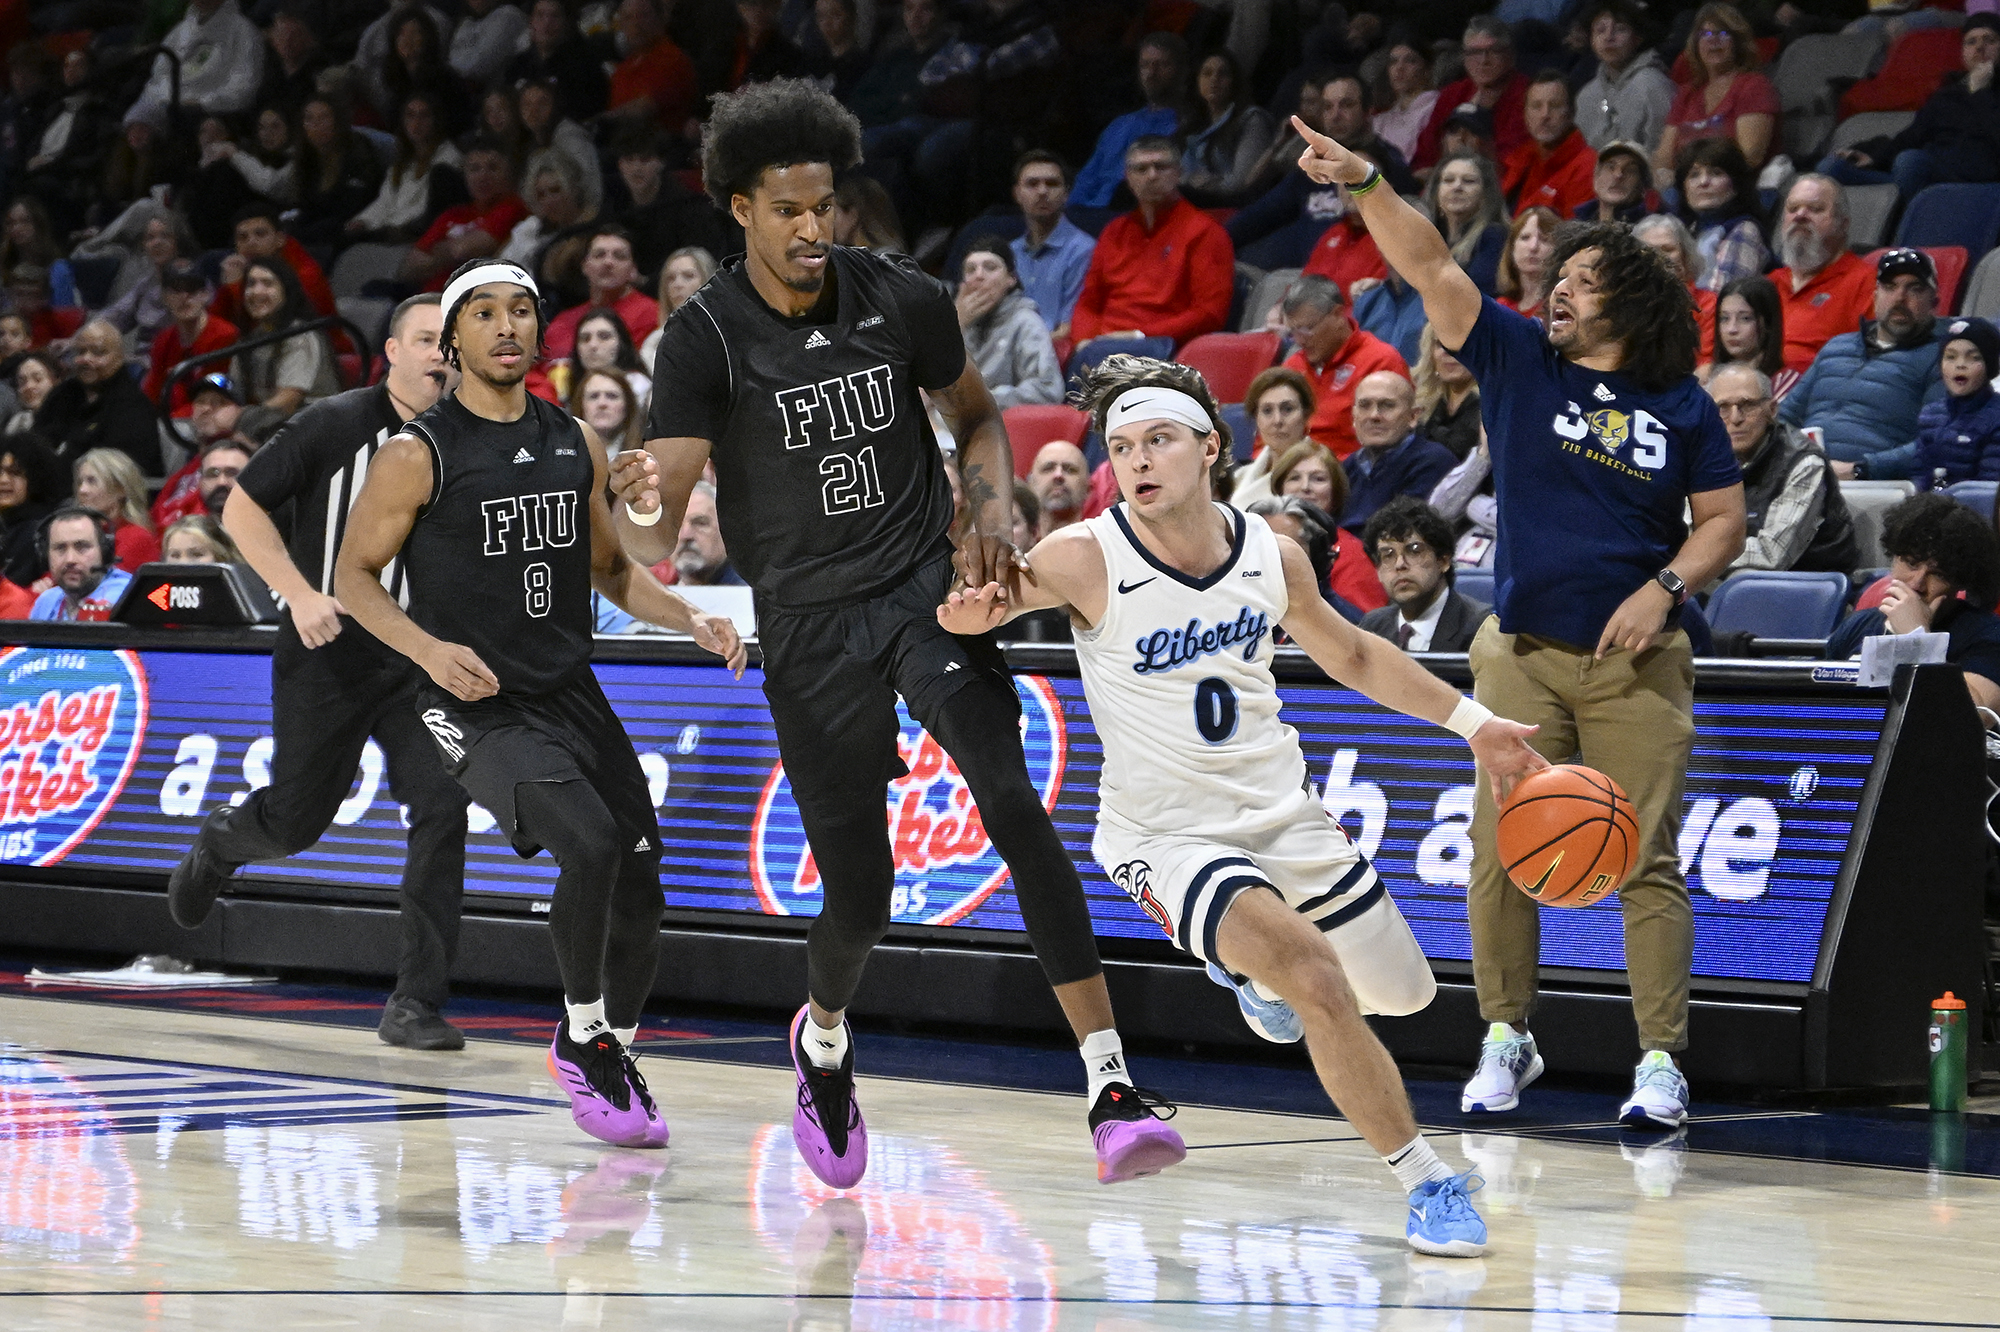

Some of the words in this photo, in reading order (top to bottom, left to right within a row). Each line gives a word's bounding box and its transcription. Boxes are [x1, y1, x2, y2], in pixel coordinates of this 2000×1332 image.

[775, 364, 895, 449] FIU
[819, 446, 885, 516] 21
[1562, 441, 1581, 454] FIU
[481, 490, 577, 556] FIU
[170, 586, 200, 608] POSS
[524, 562, 551, 618] 8
[1133, 606, 1268, 675] Liberty
[0, 684, 121, 754] ersey
[1194, 676, 1240, 746] 0
[0, 747, 98, 823] ike's
